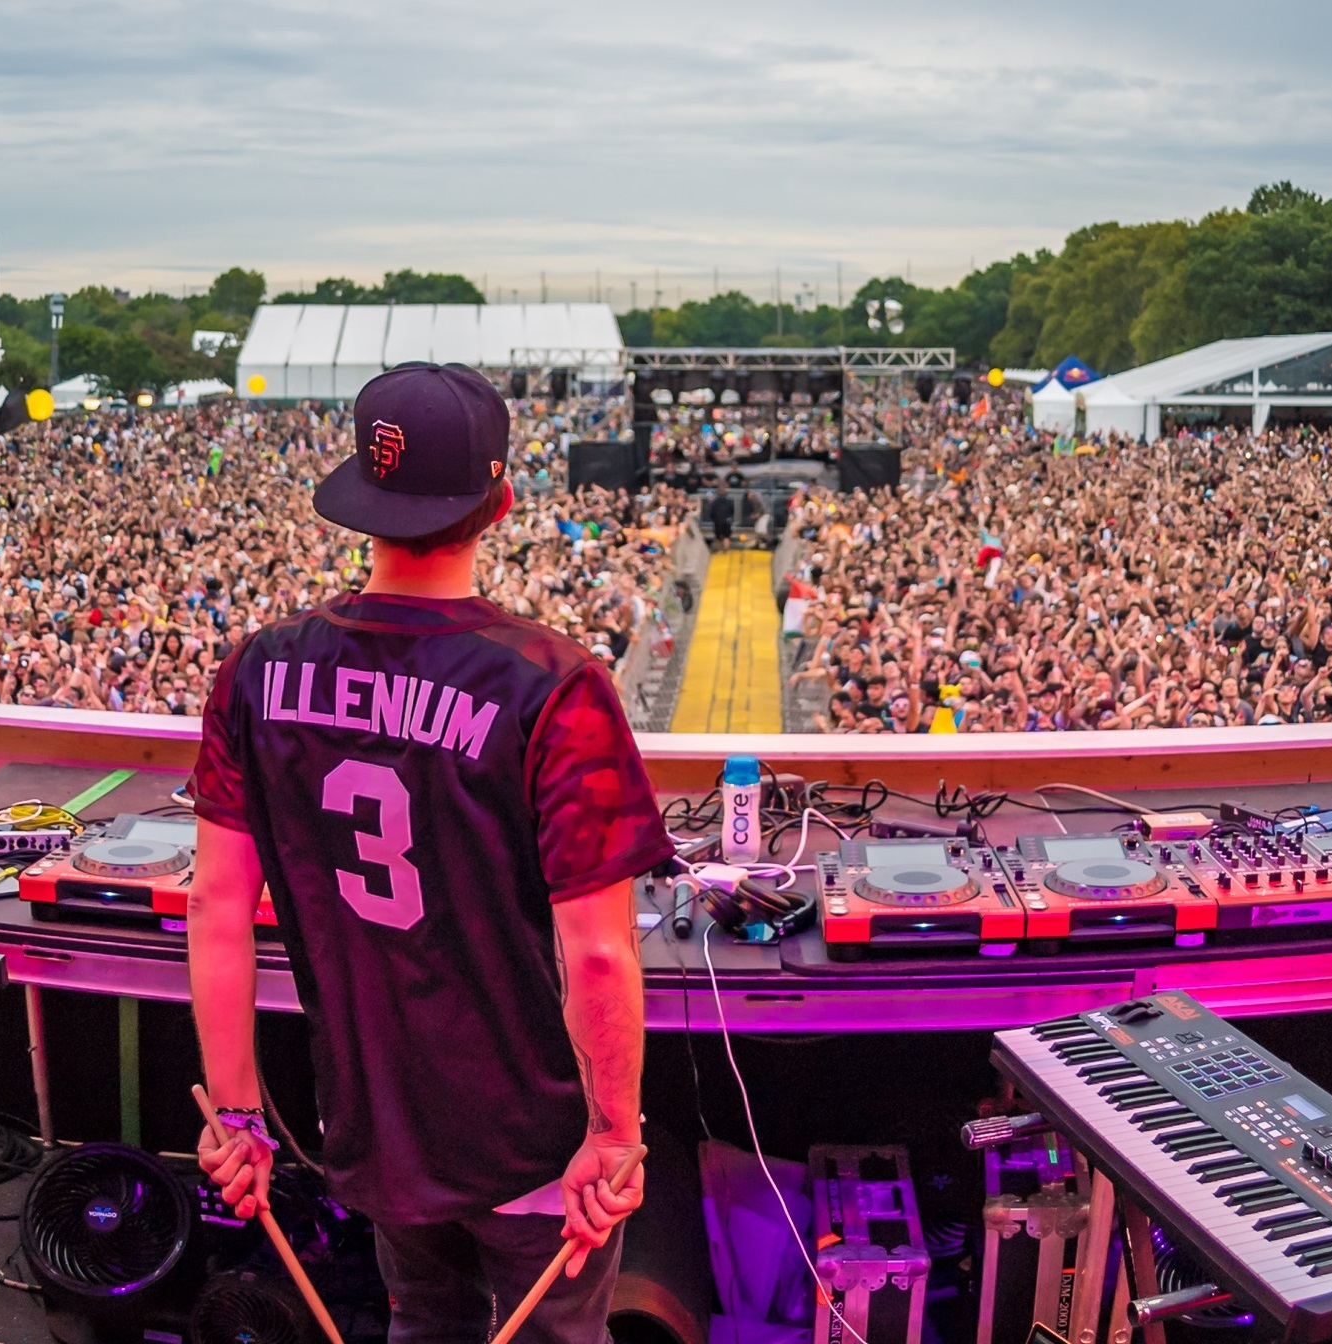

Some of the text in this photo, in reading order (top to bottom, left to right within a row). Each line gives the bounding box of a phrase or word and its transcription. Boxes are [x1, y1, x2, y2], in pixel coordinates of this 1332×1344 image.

[264, 661, 500, 760] ILLENIUM
[322, 759, 425, 930] 3
[733, 793, 749, 845] core
[1156, 995, 1201, 1019] AKAI
[831, 1302, 844, 1338] NEXUS
[1058, 1274, 1073, 1328] DJM-2000
